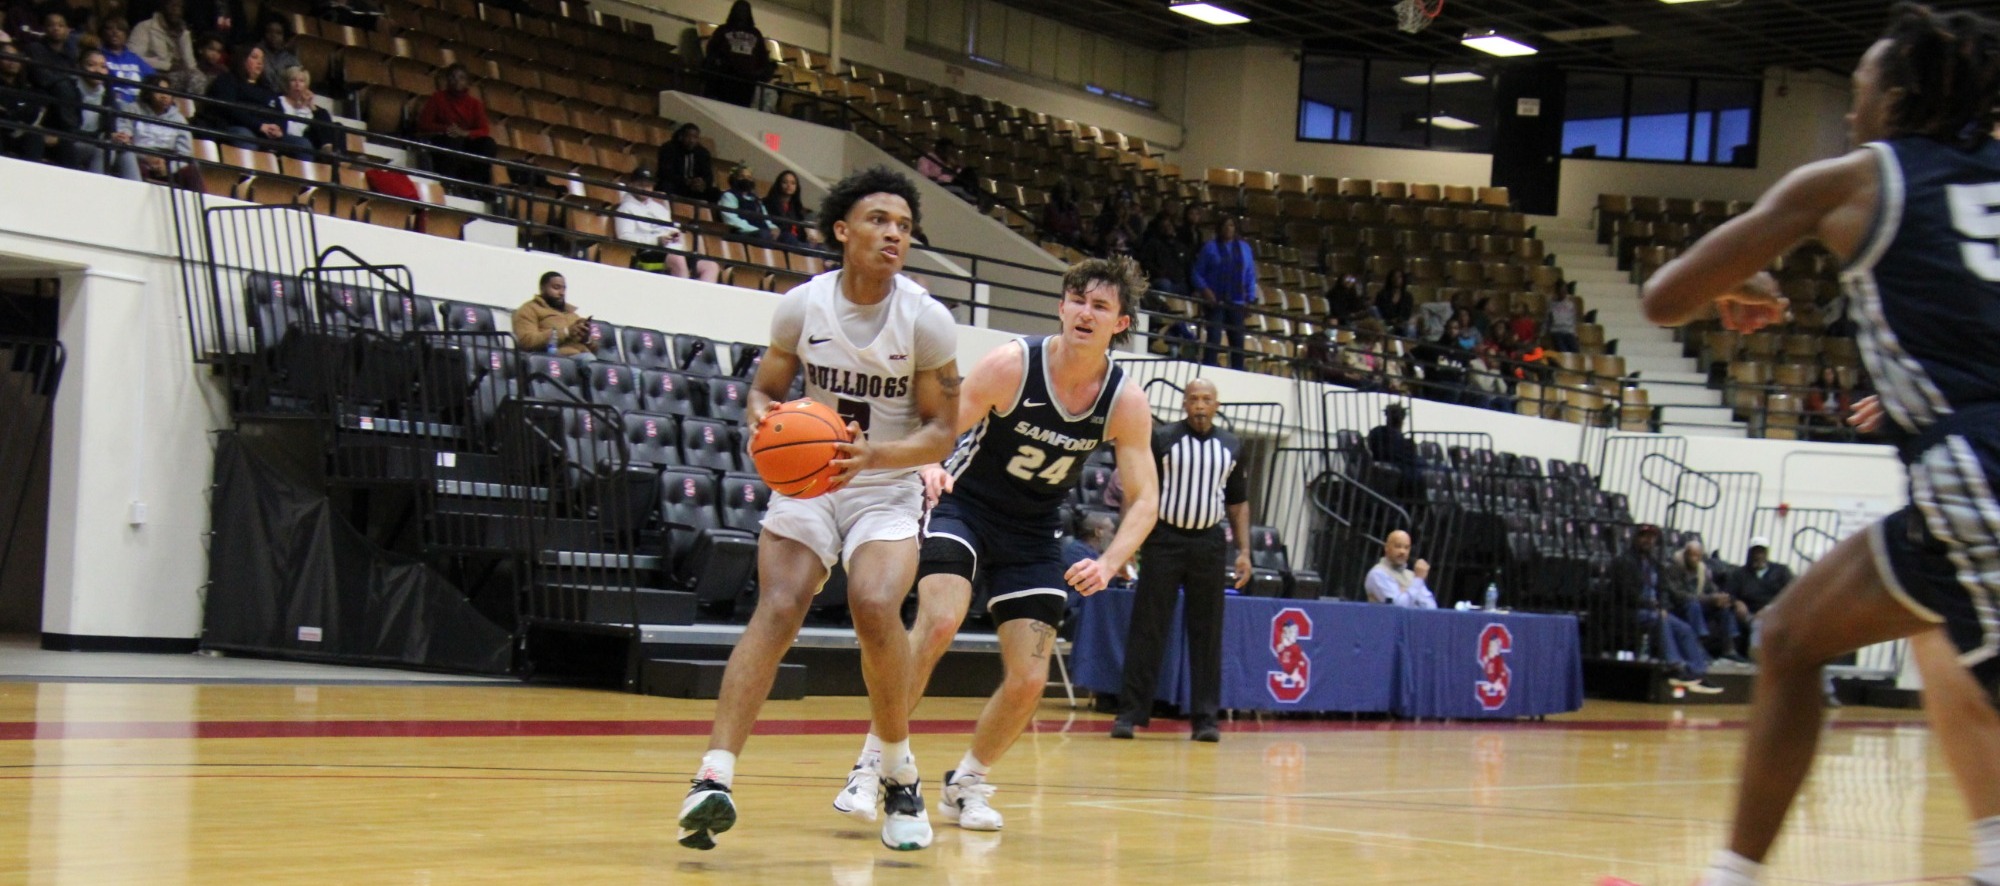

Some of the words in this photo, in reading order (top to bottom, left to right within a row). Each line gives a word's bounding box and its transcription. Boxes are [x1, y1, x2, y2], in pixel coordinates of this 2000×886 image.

[807, 362, 909, 398] BULLDOGS
[1013, 420, 1099, 451] SAMFORD
[1006, 445, 1076, 485] 24
